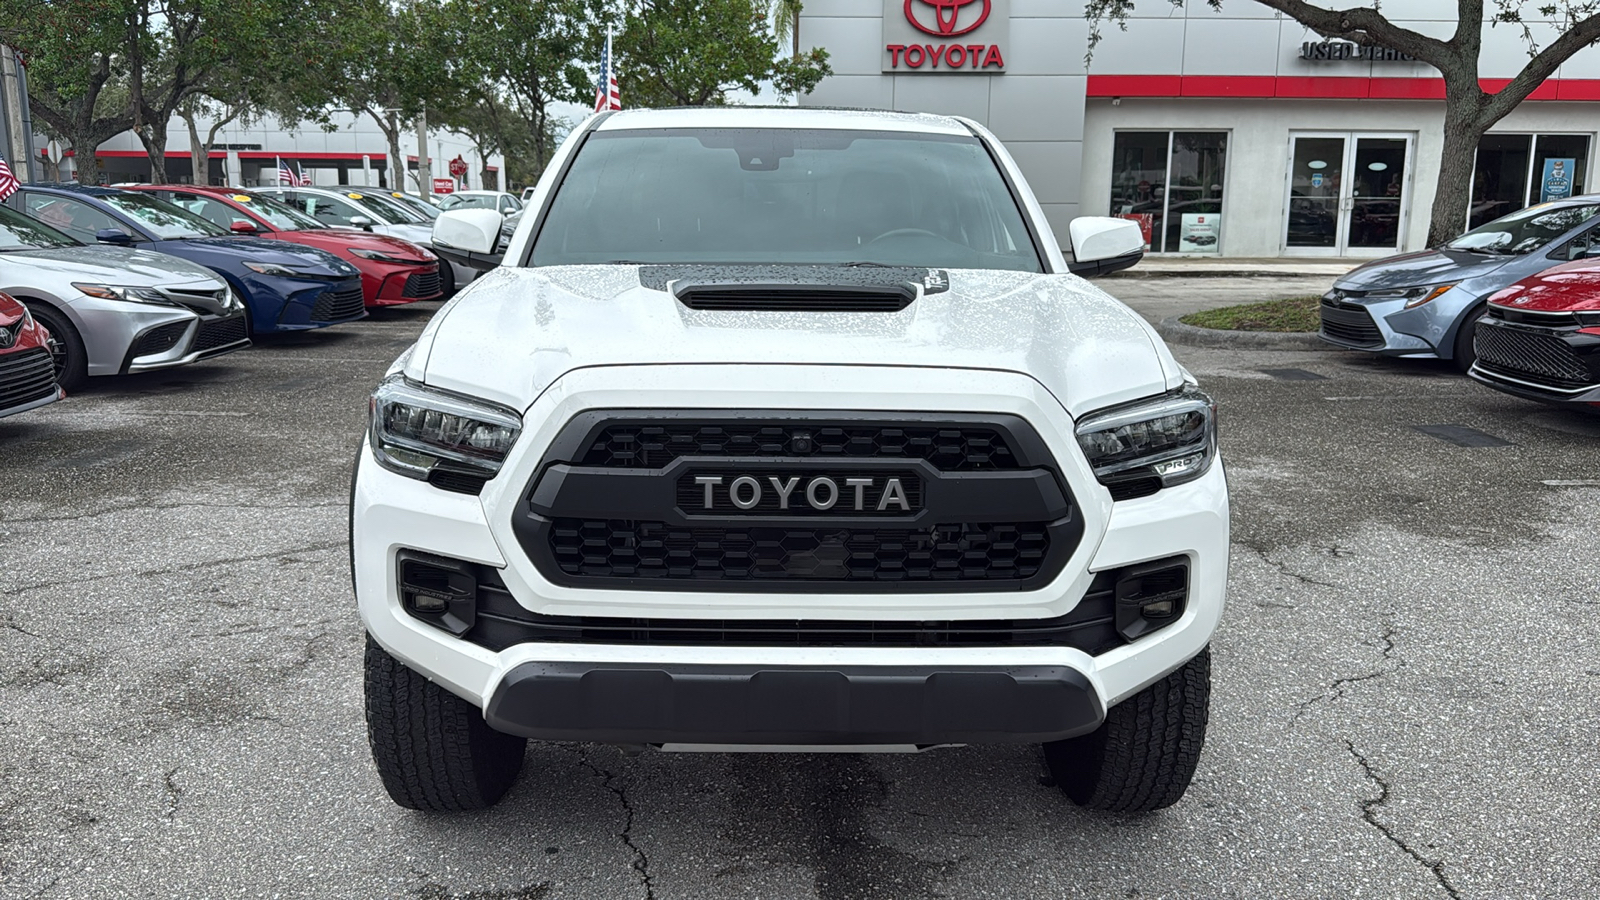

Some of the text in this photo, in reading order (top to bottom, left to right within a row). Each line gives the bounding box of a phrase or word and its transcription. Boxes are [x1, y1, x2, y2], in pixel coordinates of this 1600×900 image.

[886, 44, 1004, 68] TOYOTA
[1302, 41, 1354, 60] USED
[1162, 458, 1192, 473] PRO
[695, 476, 911, 511] TOYOTA
